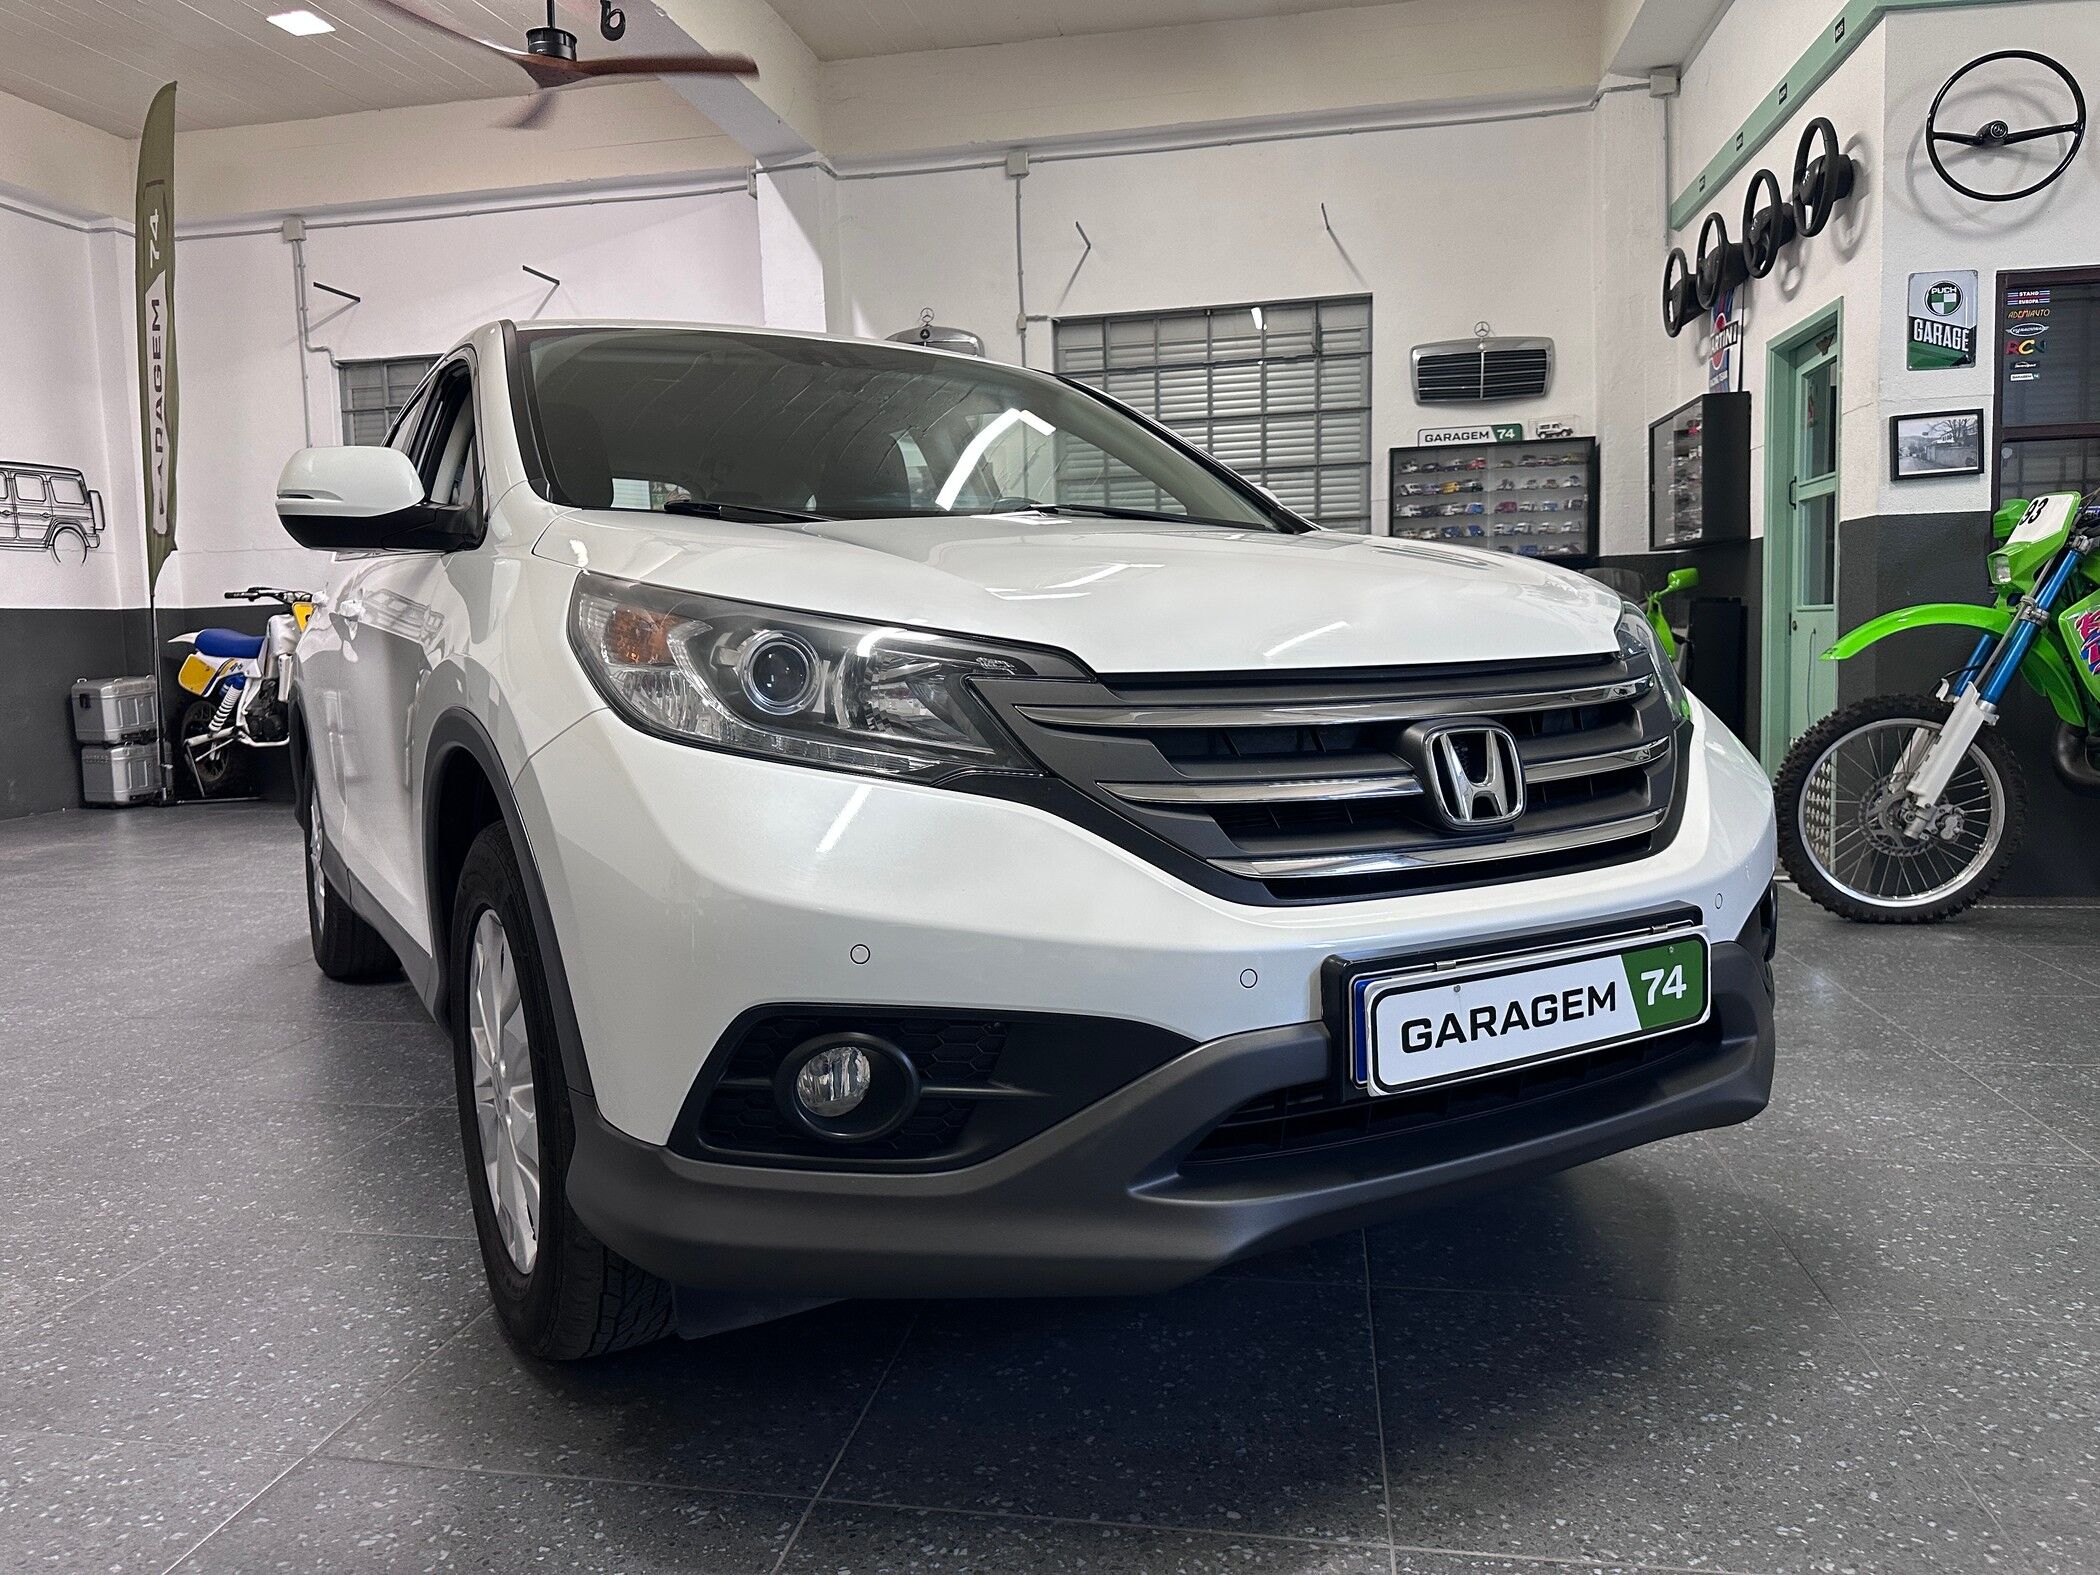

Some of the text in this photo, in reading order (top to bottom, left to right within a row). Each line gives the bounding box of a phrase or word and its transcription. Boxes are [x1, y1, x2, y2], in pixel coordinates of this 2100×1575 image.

[150, 208, 159, 269] 74
[1931, 286, 1957, 295] PUCH
[1711, 324, 1737, 351] ARTINI
[1914, 319, 1970, 352] GARAGE
[1424, 428, 1515, 443] GARAGEM 74
[2018, 497, 2049, 526] 93
[1401, 964, 1687, 1054] GARAGEM 74
